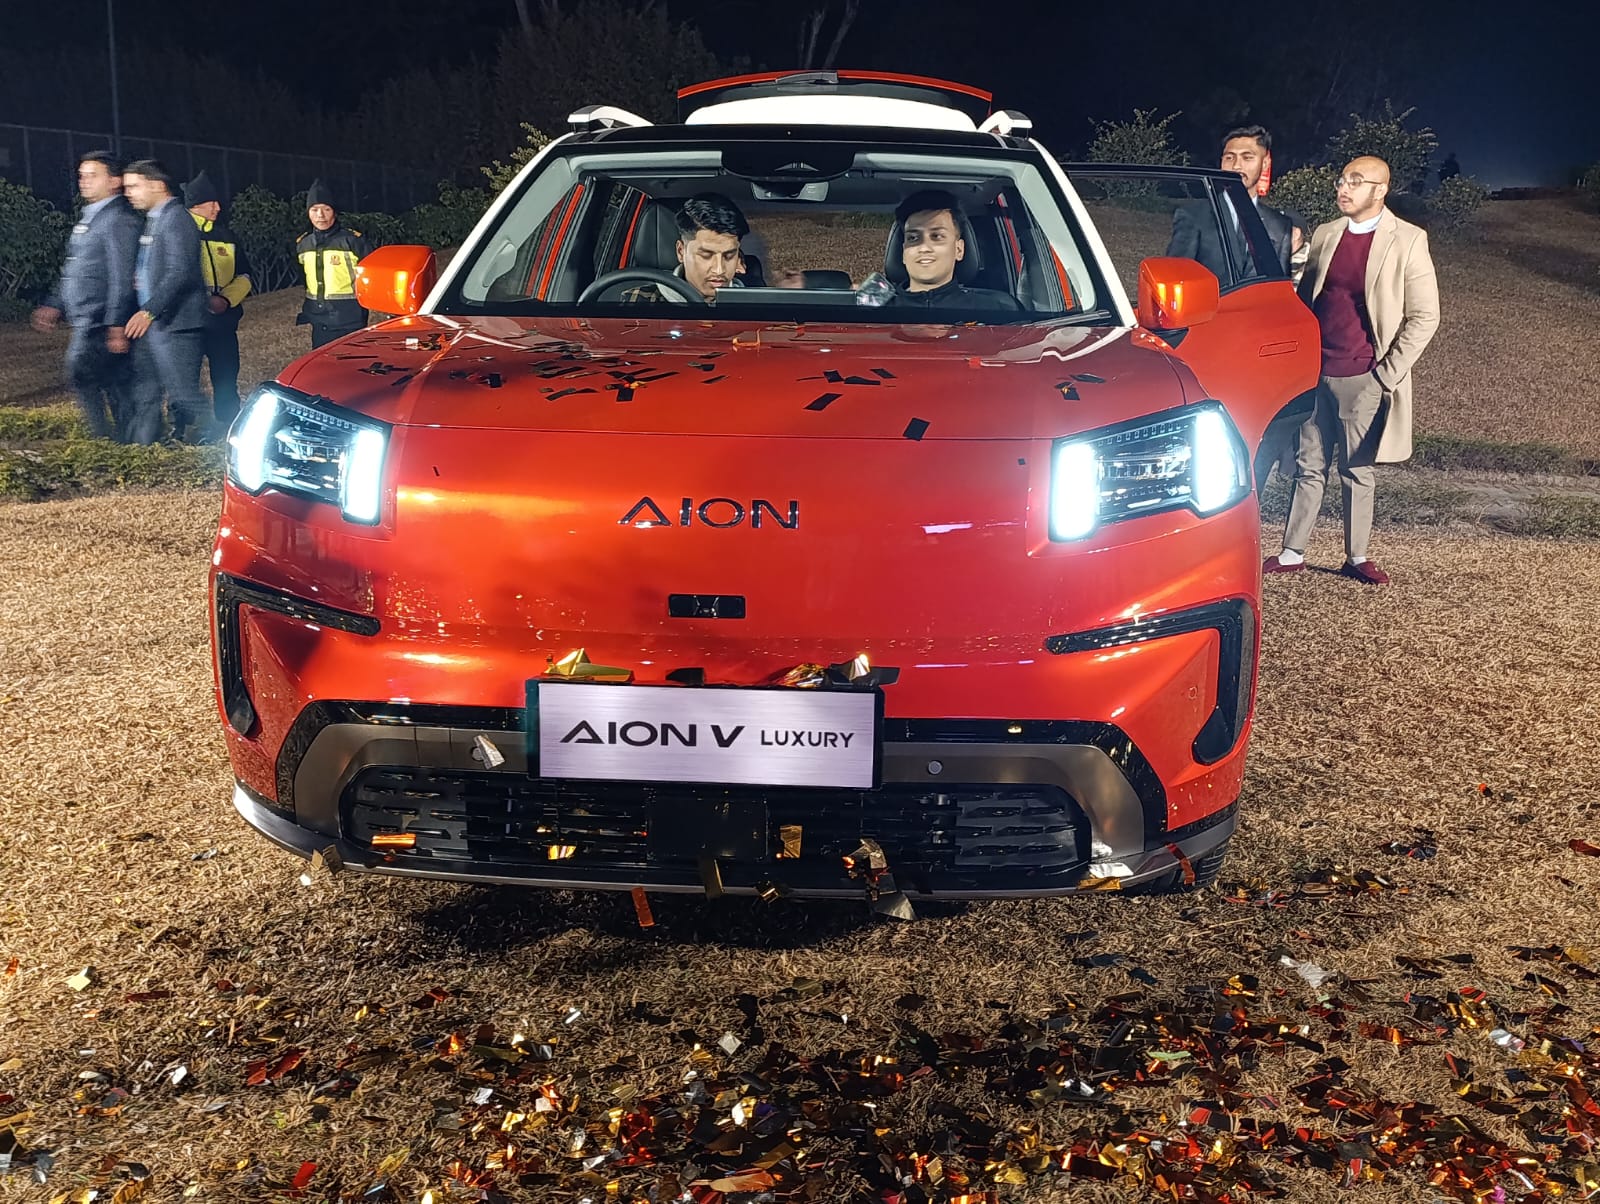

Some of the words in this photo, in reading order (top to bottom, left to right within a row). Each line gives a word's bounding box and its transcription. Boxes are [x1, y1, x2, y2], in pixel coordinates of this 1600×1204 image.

[617, 496, 799, 529] AION
[559, 719, 697, 747] AION
[711, 725, 746, 748] V
[760, 730, 855, 749] LUXURY
